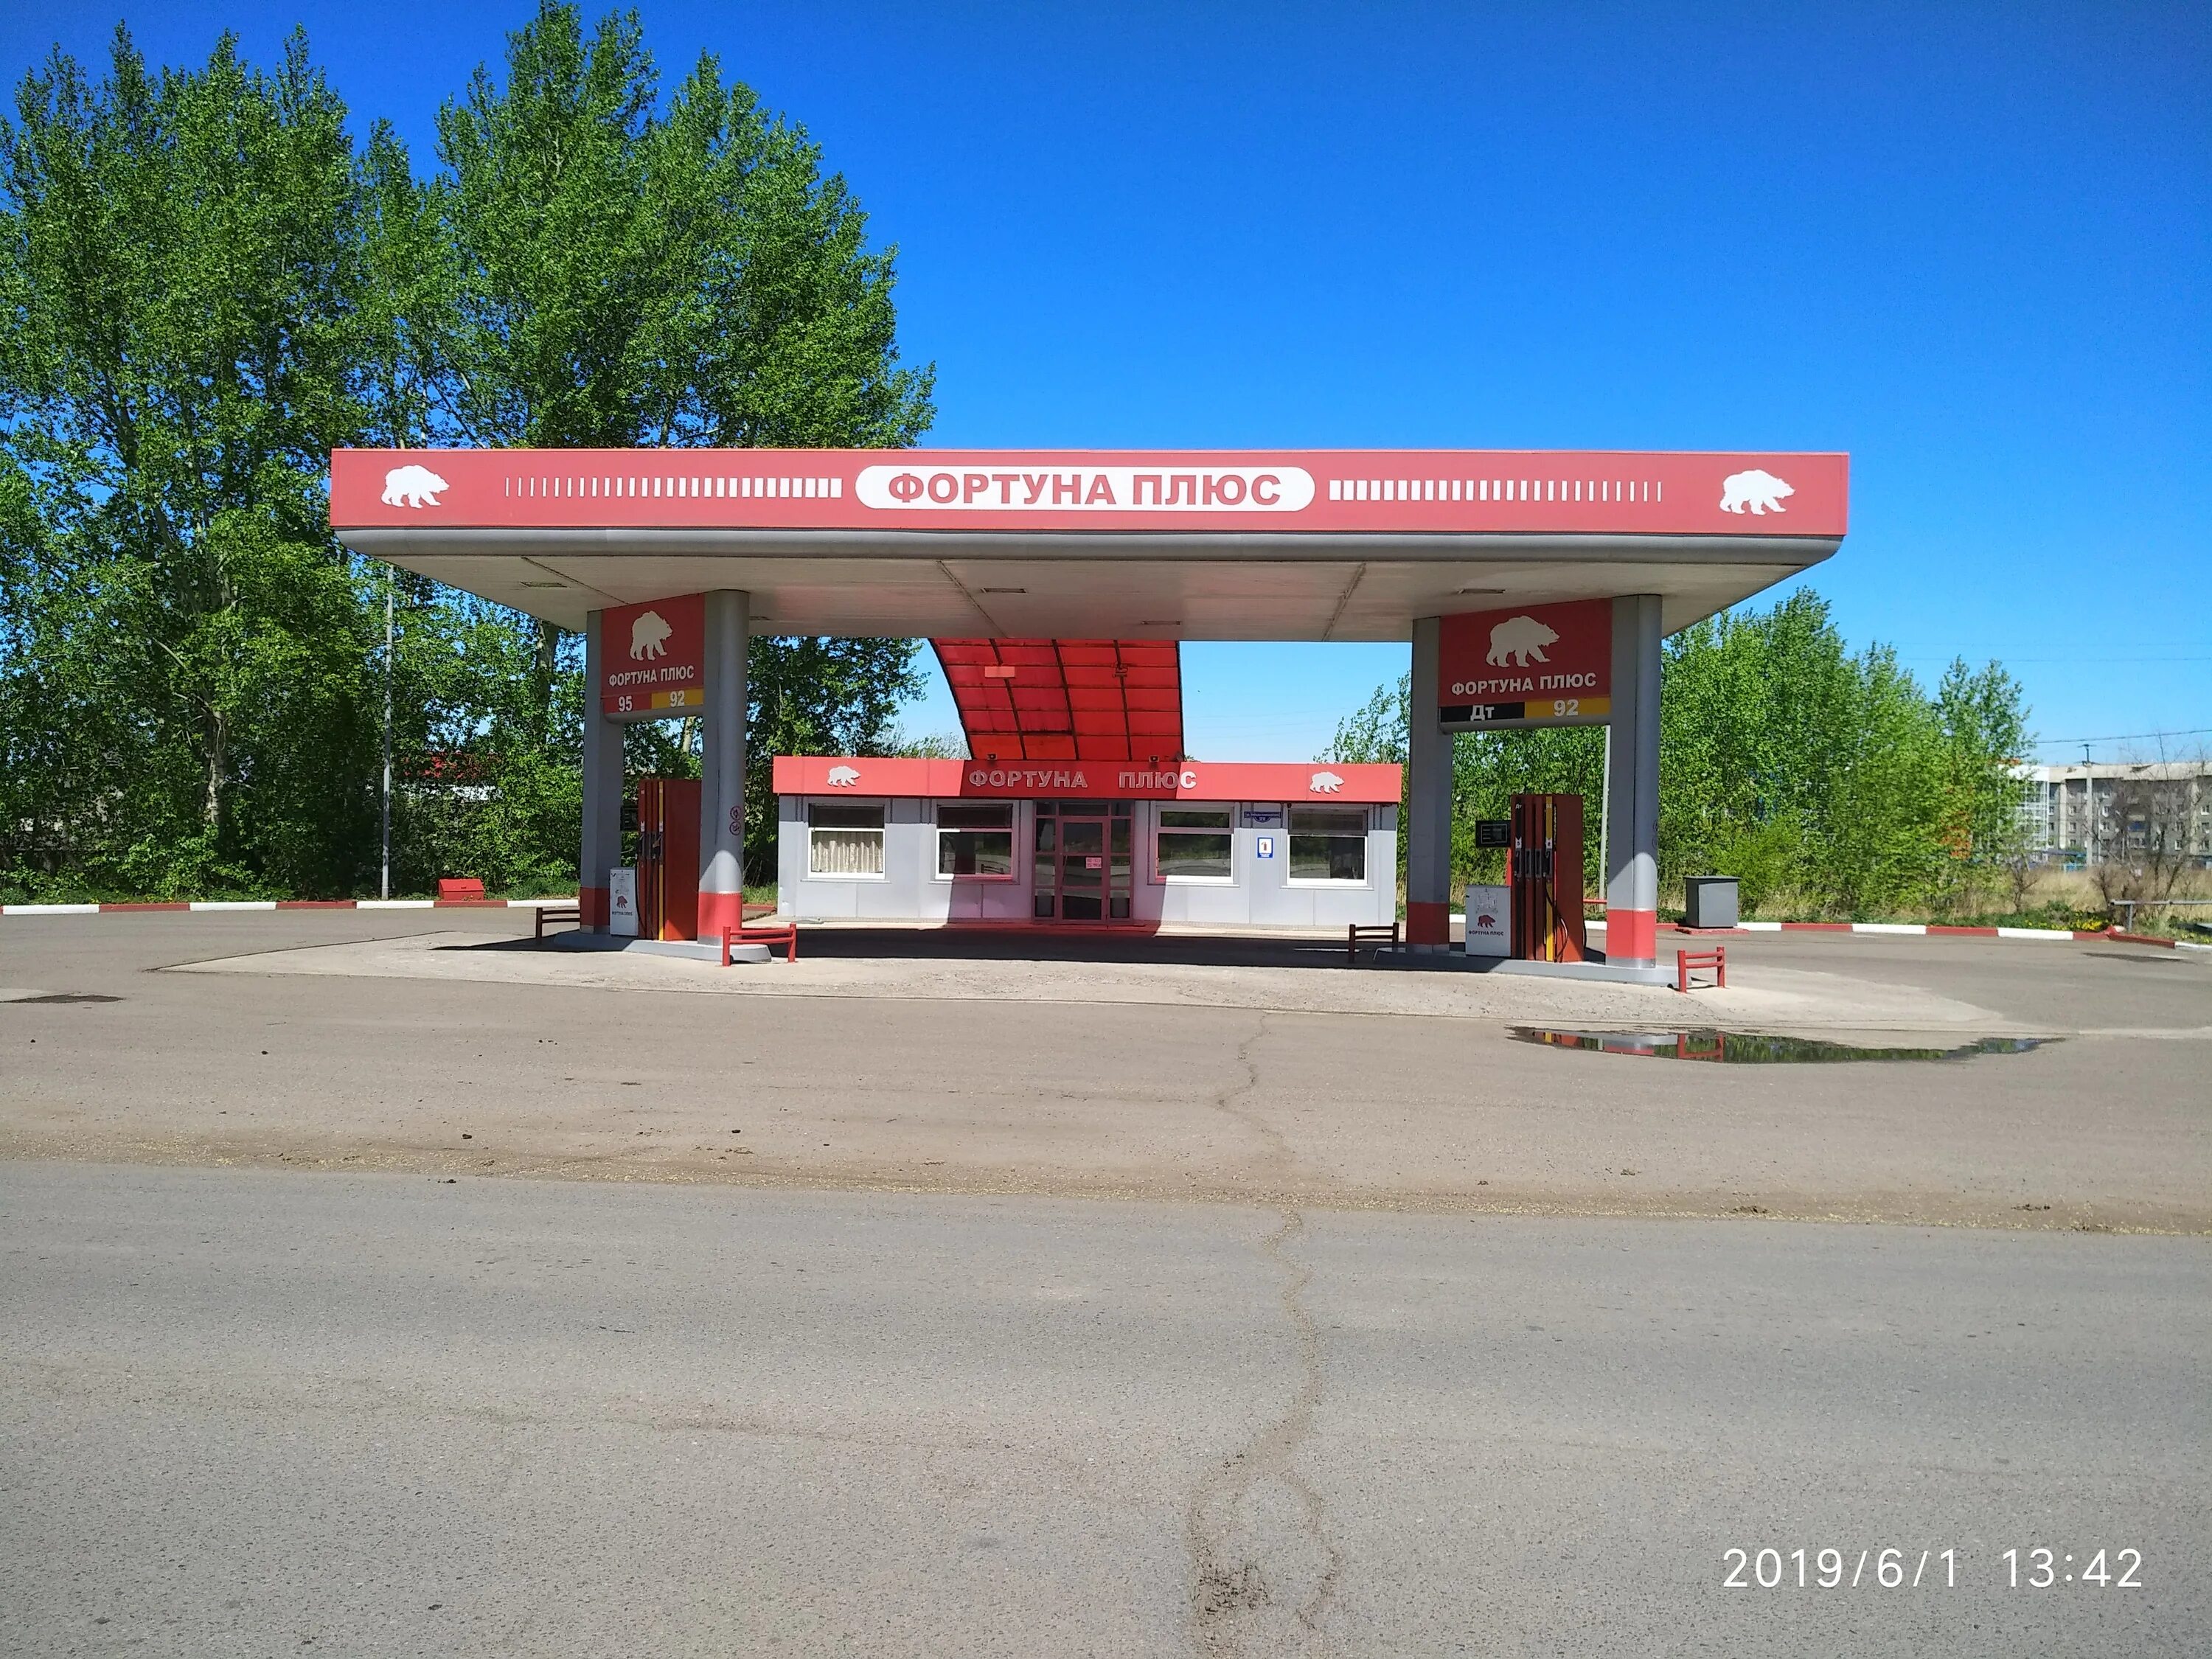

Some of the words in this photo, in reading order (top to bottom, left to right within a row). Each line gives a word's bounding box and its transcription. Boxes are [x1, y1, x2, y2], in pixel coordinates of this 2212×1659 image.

[888, 472, 1116, 506] ФОРТУНА
[1133, 474, 1281, 507] ПЛЮС
[608, 669, 658, 687] ФОРТУНА
[660, 665, 695, 682] ПЛЮС
[1451, 677, 1534, 696] ФОРТУНА
[1540, 672, 1597, 690] ПЛЮС
[618, 695, 633, 712] 95
[669, 690, 685, 708] 92
[1554, 699, 1579, 717] 92
[1470, 704, 1495, 722] Дт
[969, 769, 1088, 788] ФОРТУНА
[1119, 771, 1198, 790] ПЛЮС
